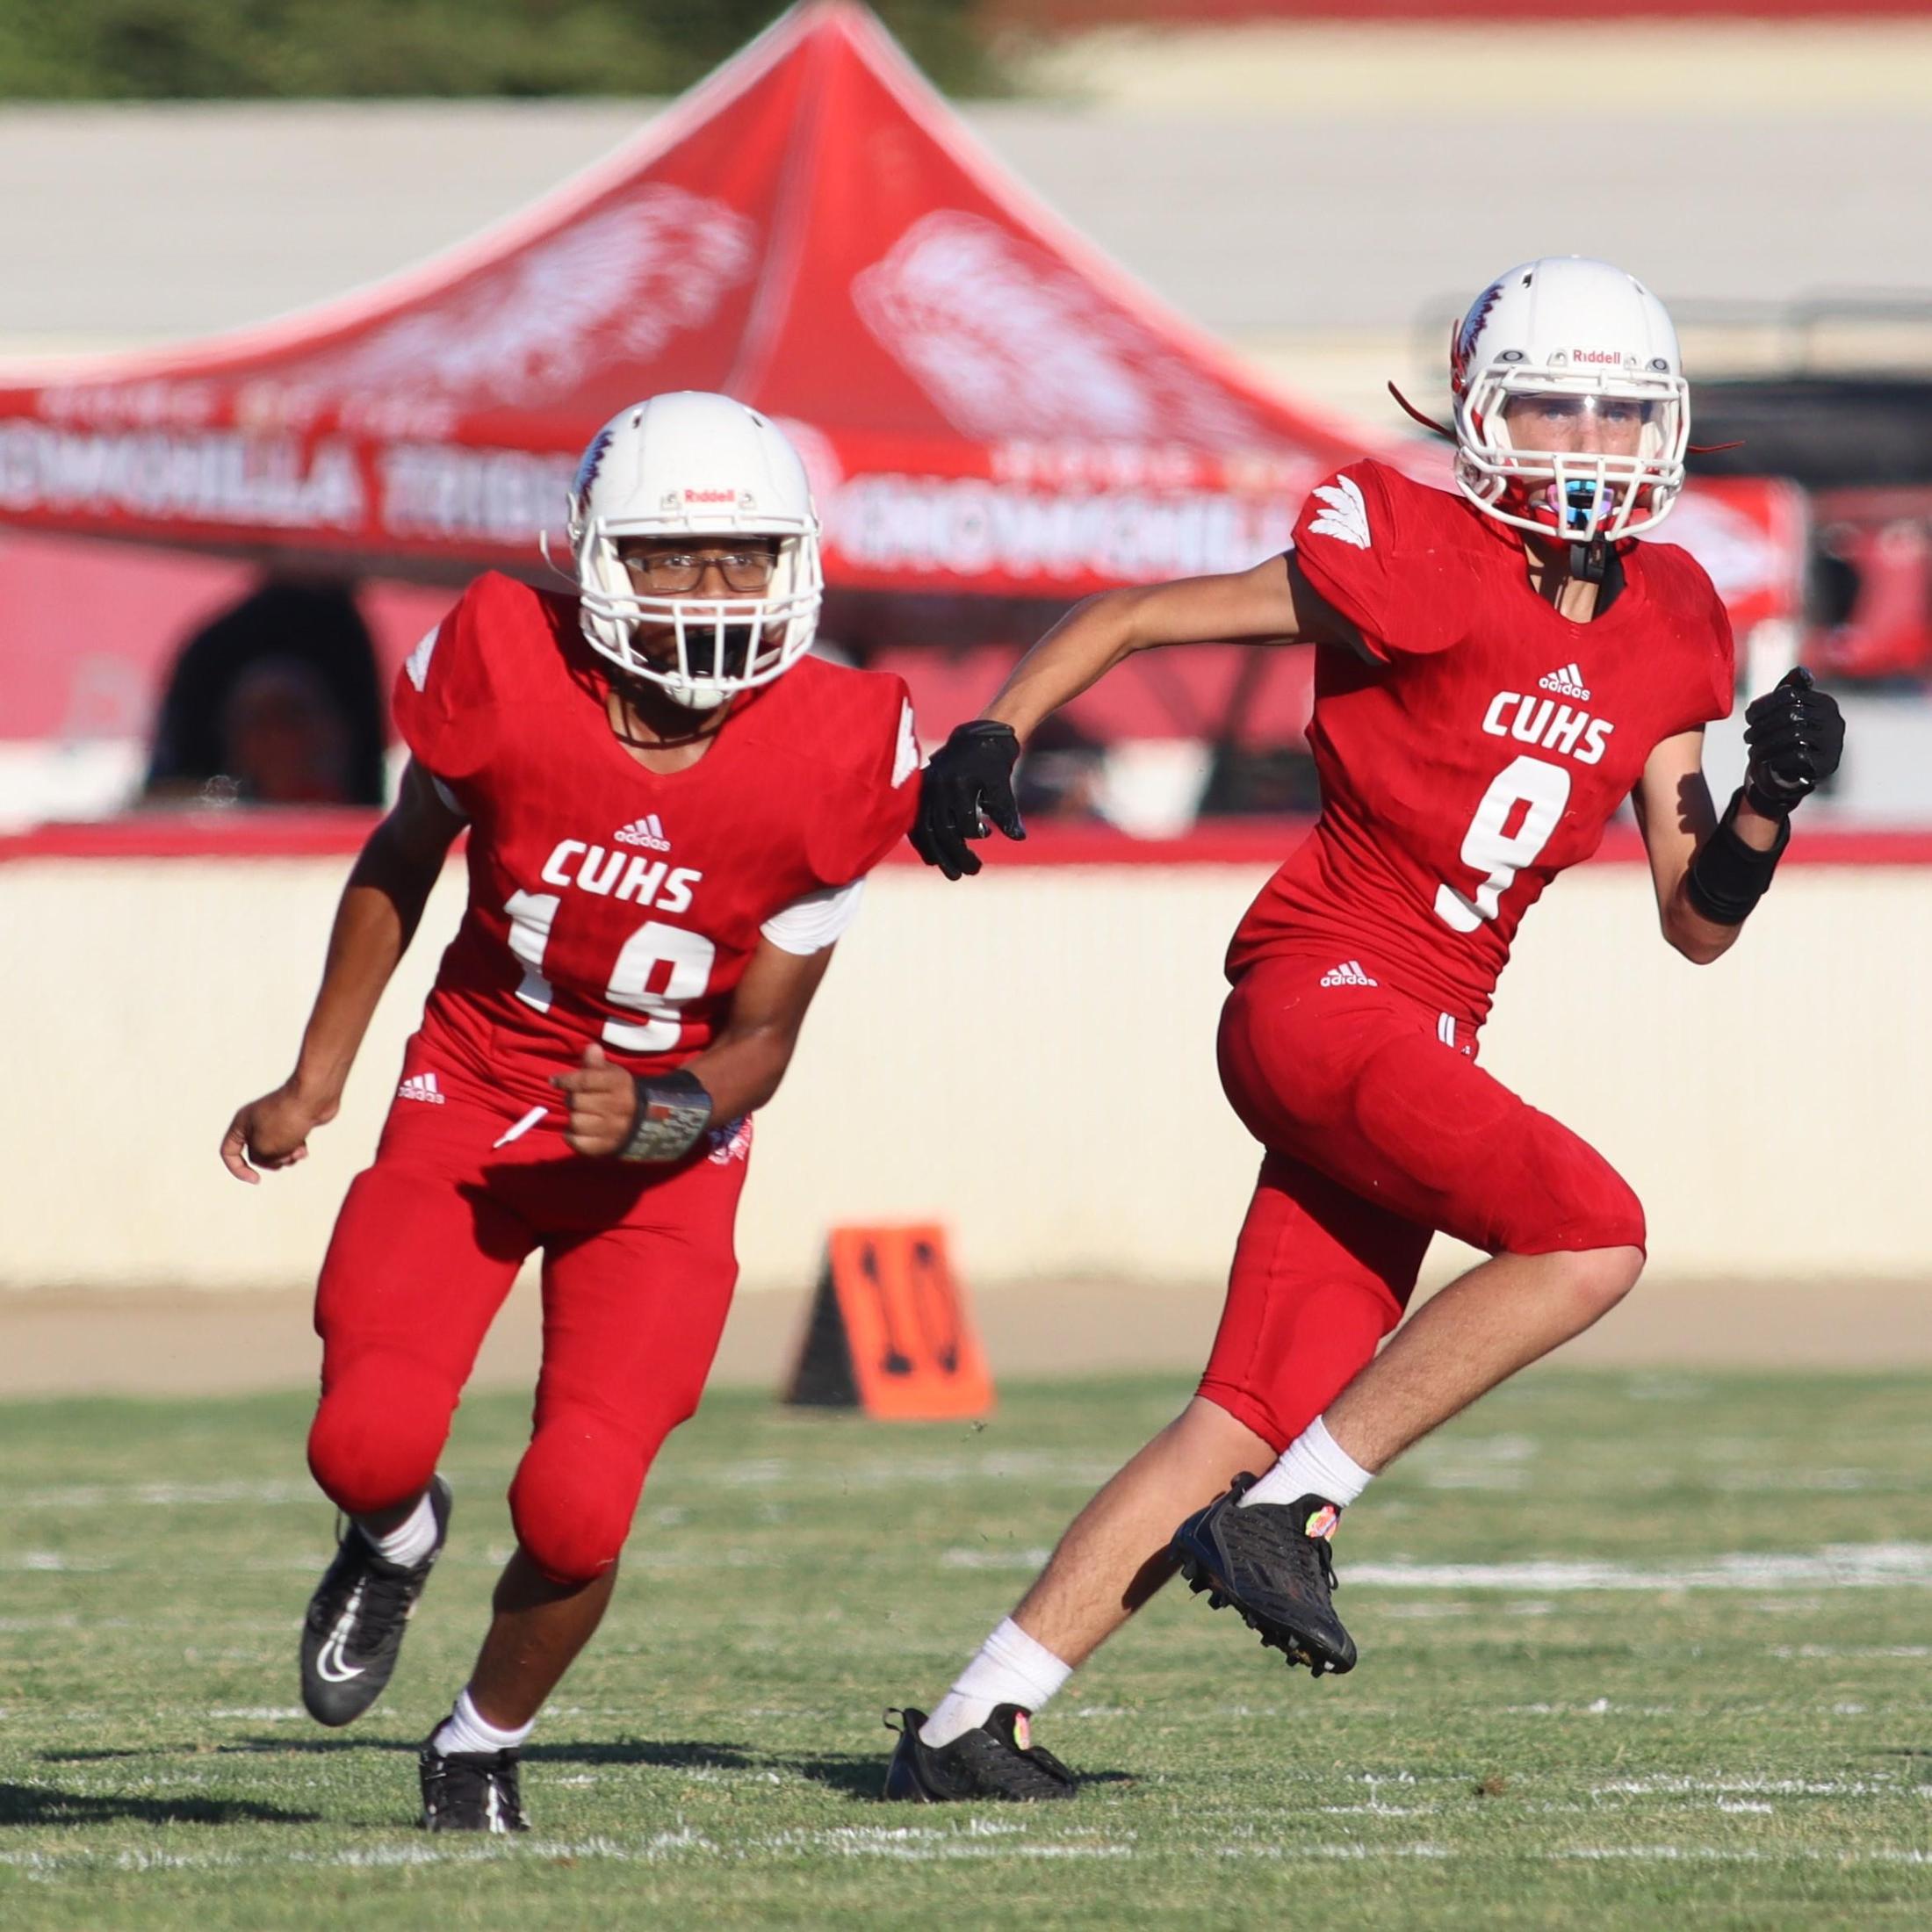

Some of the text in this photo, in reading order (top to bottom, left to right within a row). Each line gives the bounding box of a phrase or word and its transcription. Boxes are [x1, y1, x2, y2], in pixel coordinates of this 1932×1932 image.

[1573, 350, 1620, 364] Riddell
[684, 488, 735, 503] Riddell
[1539, 675, 1590, 702] adidas
[1481, 691, 1615, 765] CUHS
[614, 829, 672, 852] adidas
[1433, 754, 1571, 933] 9
[541, 838, 703, 913] CUHS
[503, 888, 717, 1051] 19
